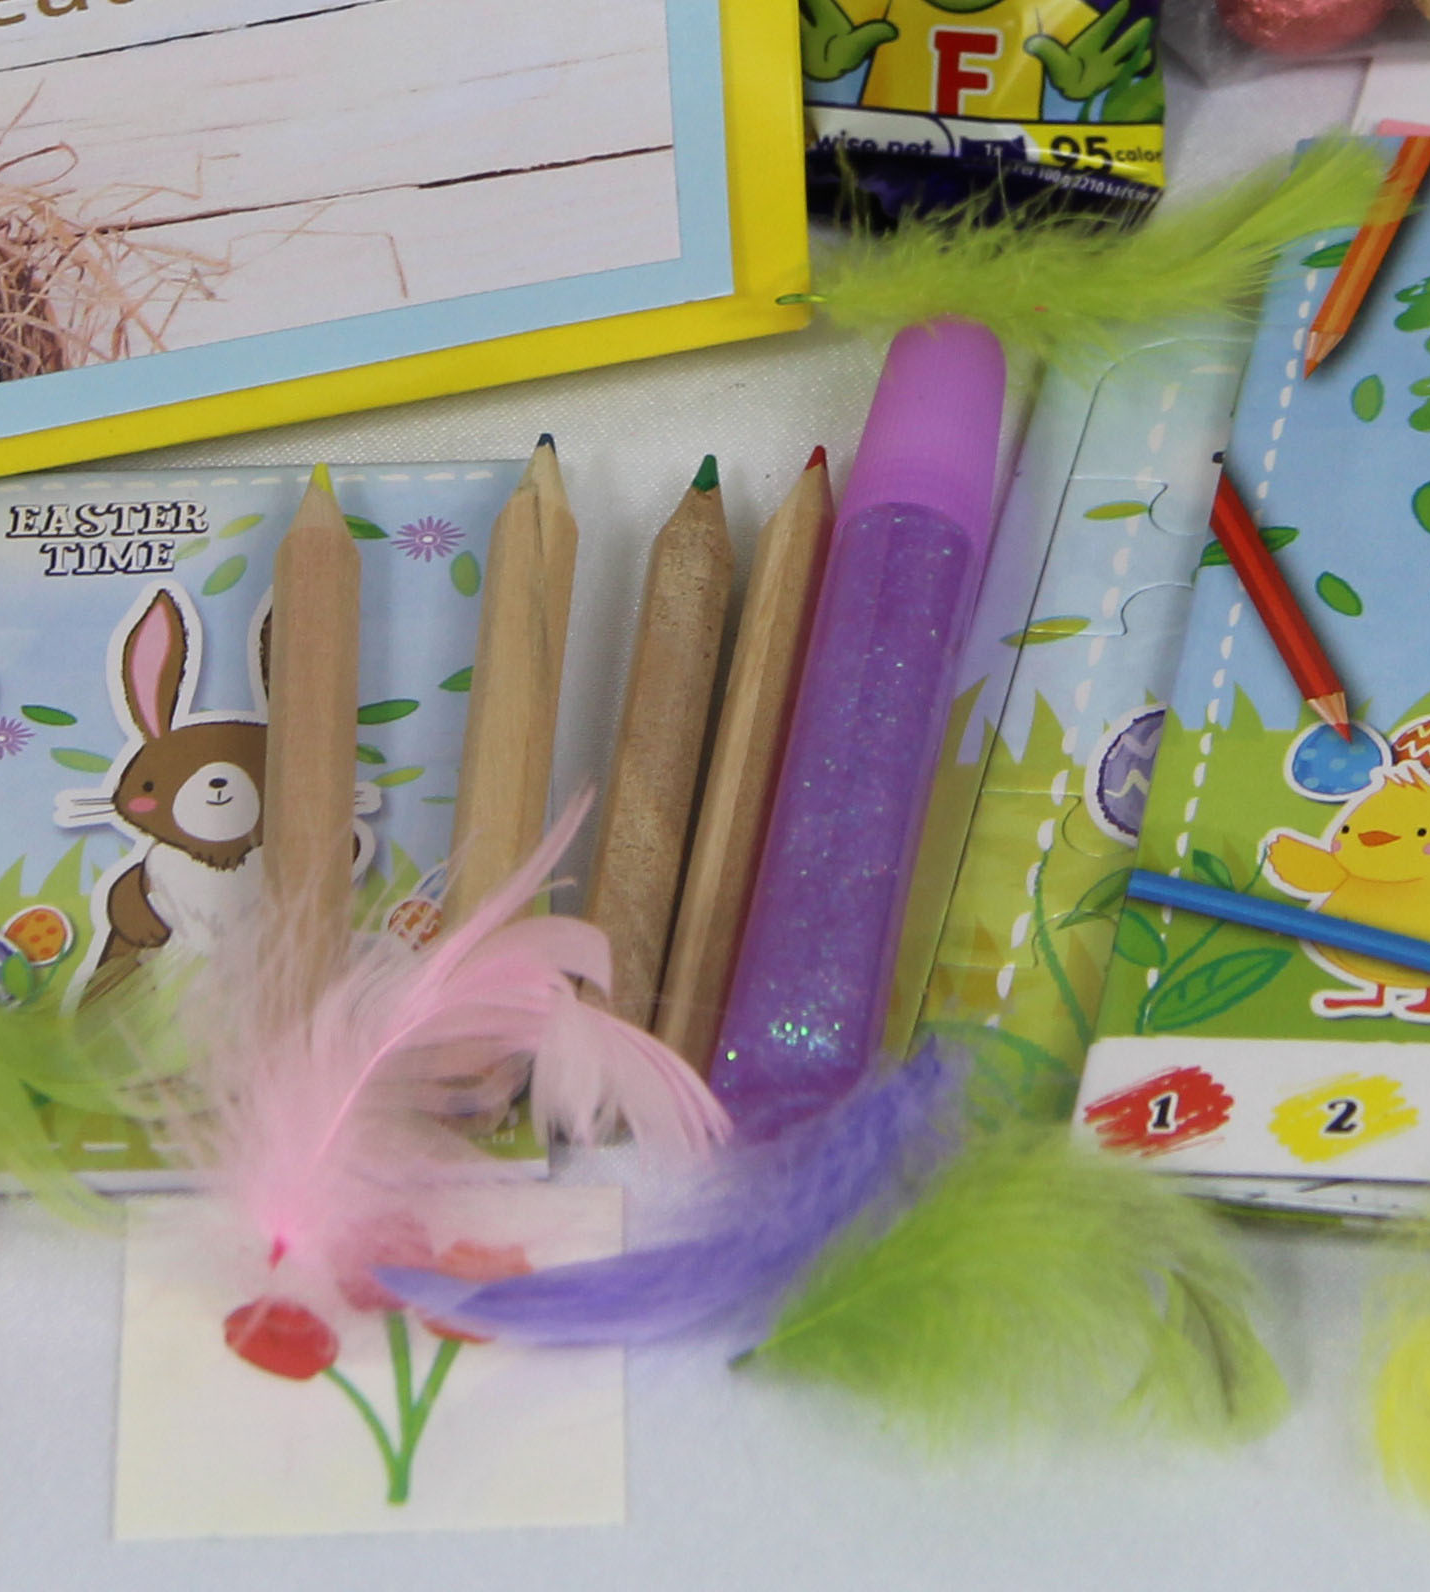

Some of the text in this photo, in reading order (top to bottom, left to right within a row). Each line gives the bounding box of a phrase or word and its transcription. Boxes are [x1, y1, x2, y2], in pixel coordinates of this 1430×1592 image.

[934, 30, 999, 115] F
[1049, 134, 1114, 175] 95
[5, 500, 210, 540] EASTER
[40, 538, 175, 577] TIME
[1147, 1093, 1175, 1134] 1
[1323, 1097, 1360, 1136] 2
